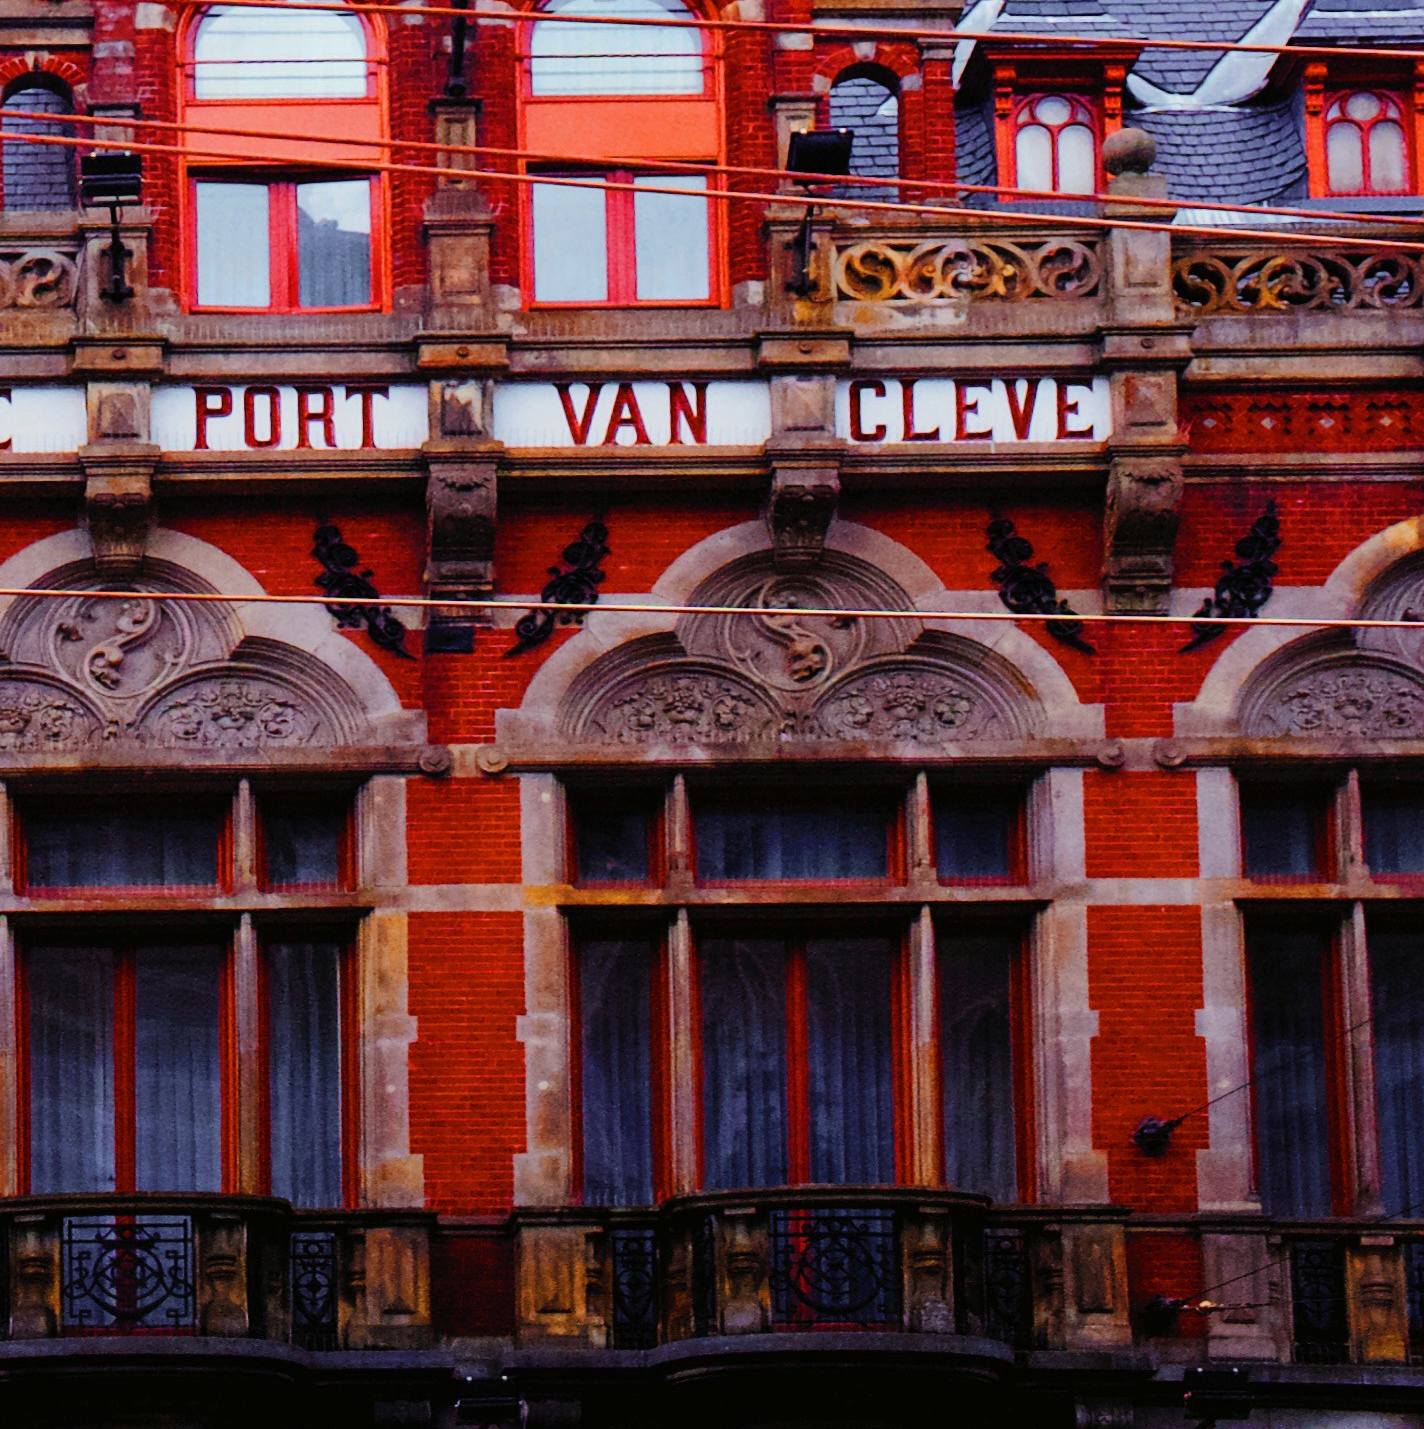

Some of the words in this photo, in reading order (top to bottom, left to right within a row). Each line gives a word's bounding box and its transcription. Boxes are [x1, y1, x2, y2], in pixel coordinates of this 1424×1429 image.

[192, 384, 391, 450] PORT
[552, 380, 710, 446] VAN
[846, 377, 1096, 442] CLEVE
